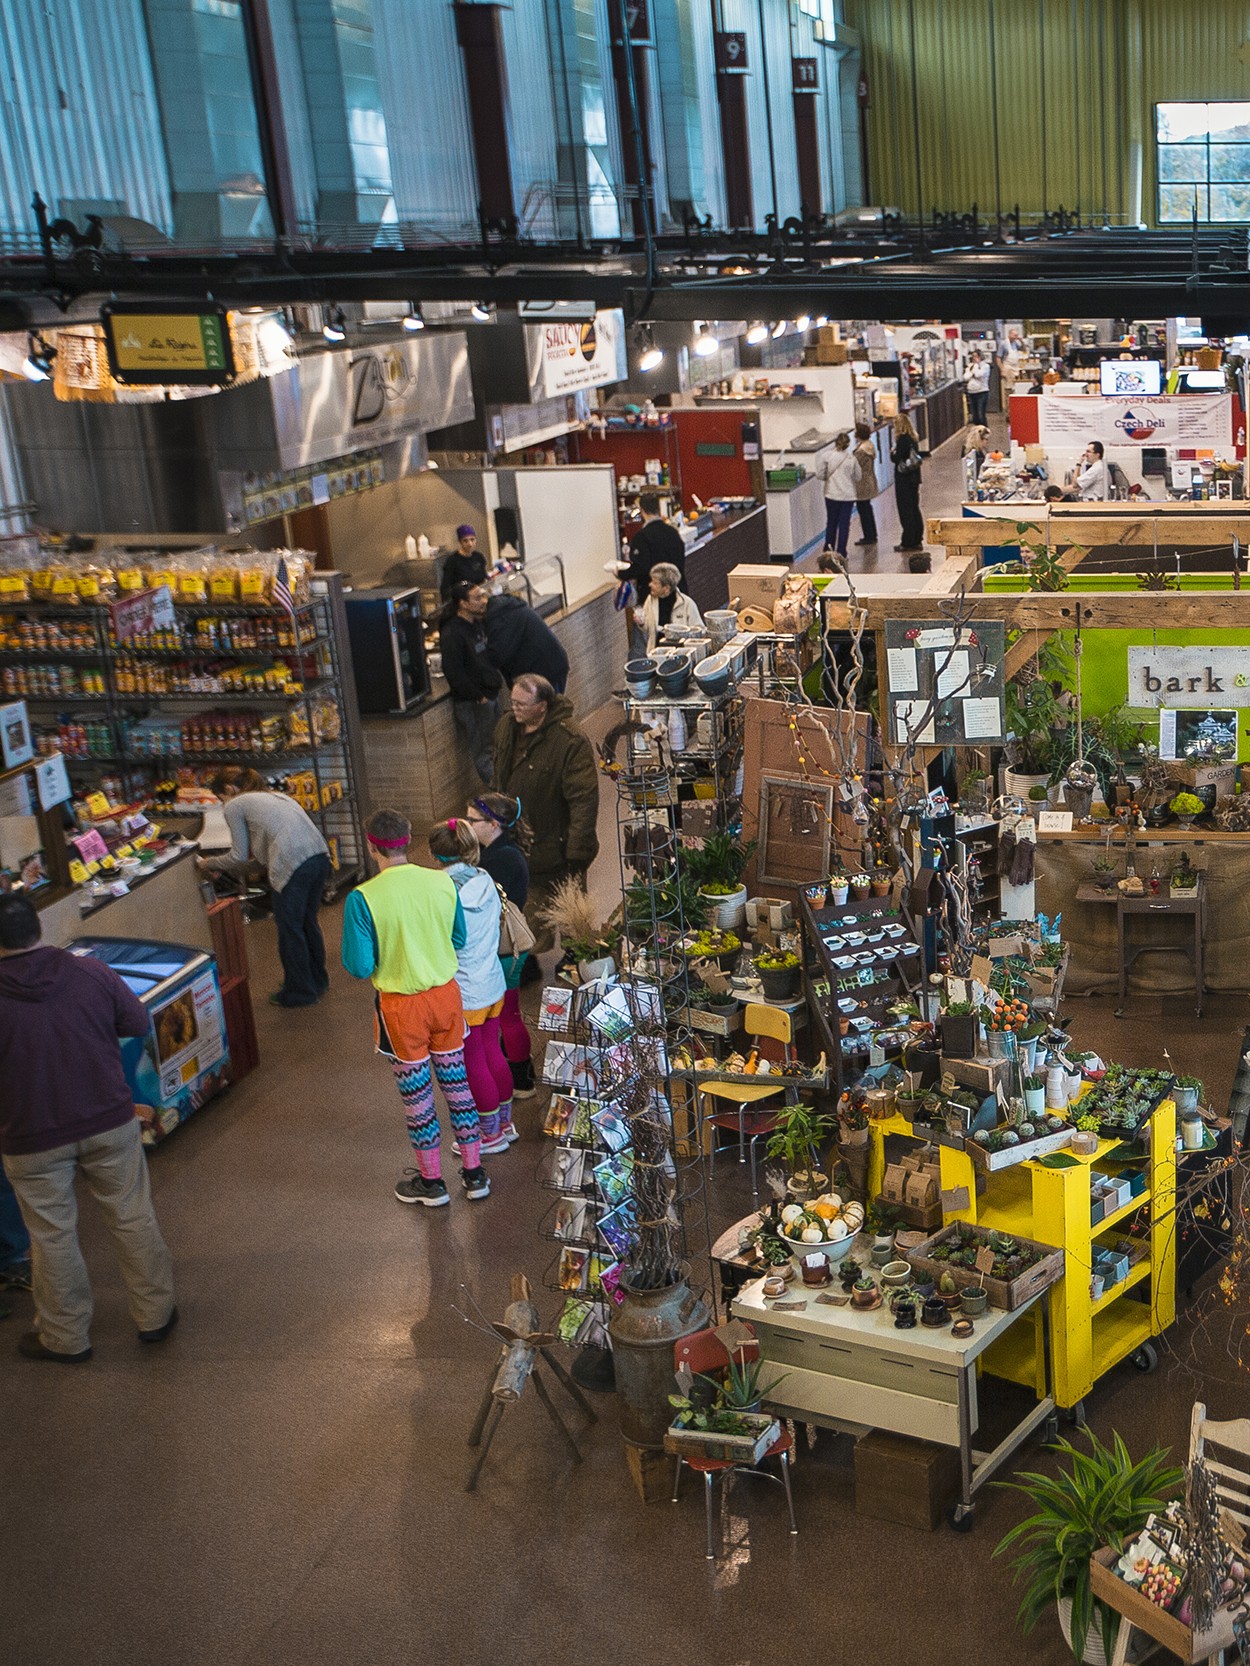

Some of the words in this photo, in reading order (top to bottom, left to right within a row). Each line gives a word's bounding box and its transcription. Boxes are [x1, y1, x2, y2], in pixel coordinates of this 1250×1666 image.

[627, 7, 639, 30] 7
[727, 41, 741, 60] 9
[800, 65, 815, 82] 11
[1146, 396, 1172, 404] Deals
[1114, 418, 1144, 428] Czech
[1146, 418, 1165, 428] Deli
[1143, 665, 1225, 693] bark
[1235, 672, 1249, 688] &
[1207, 768, 1236, 780] GARDEN
